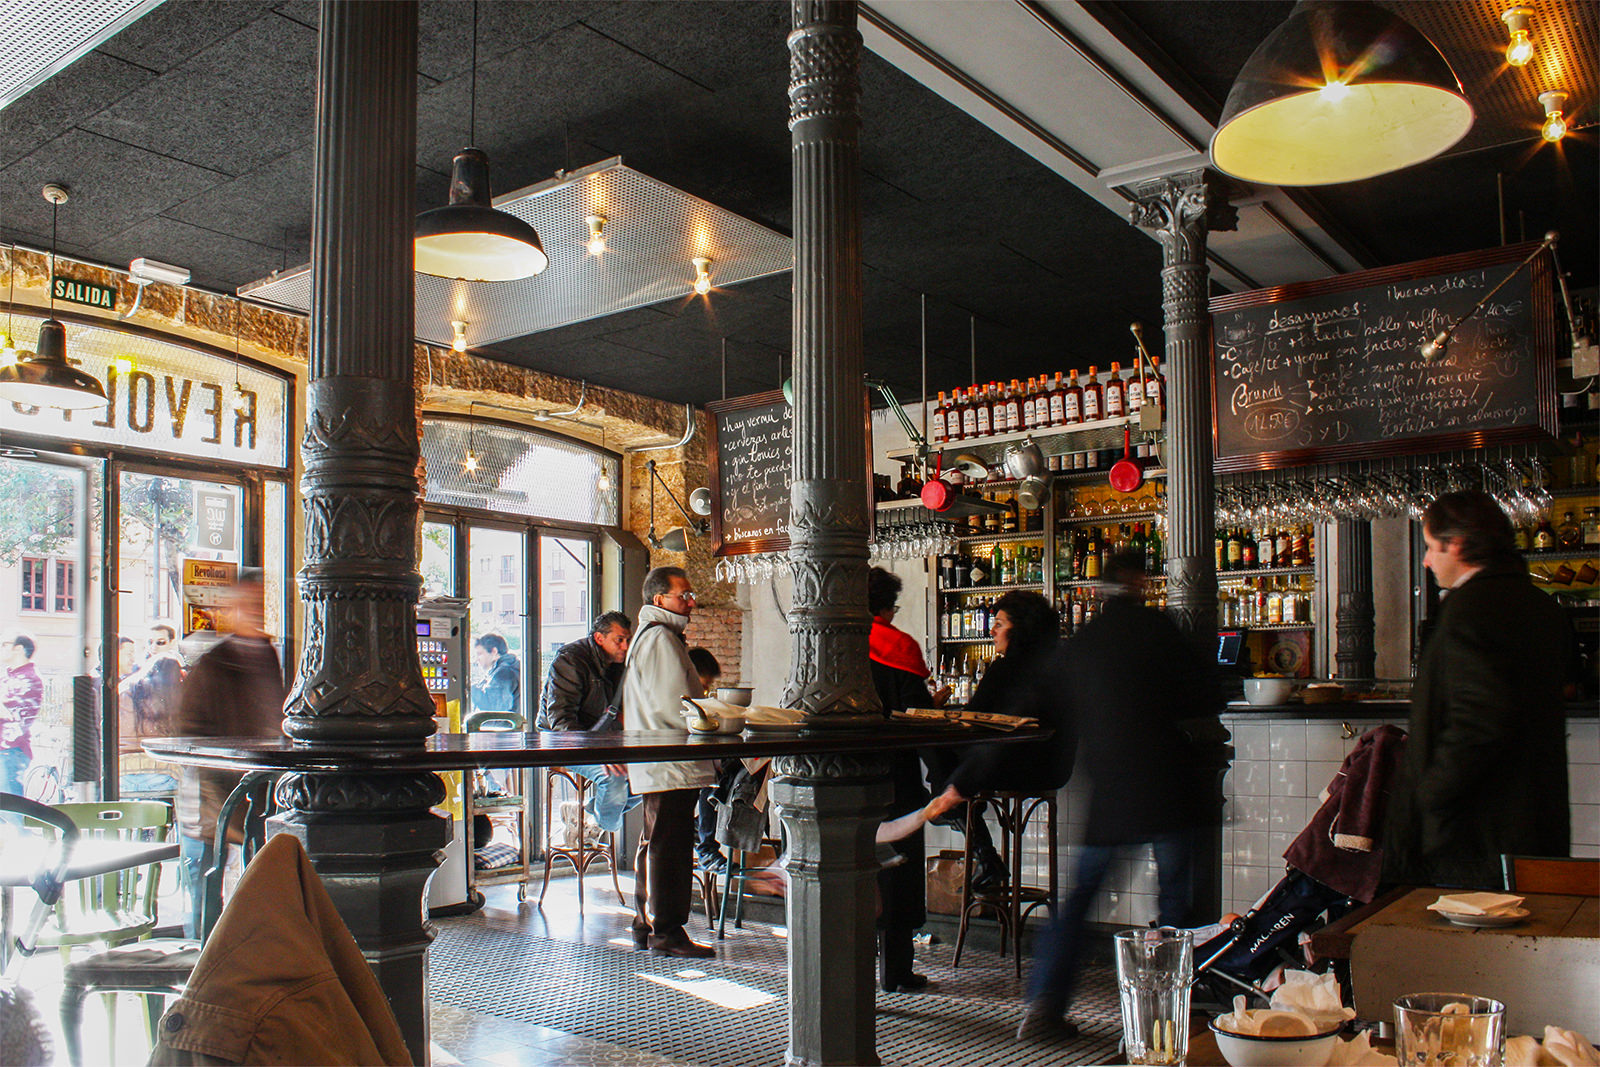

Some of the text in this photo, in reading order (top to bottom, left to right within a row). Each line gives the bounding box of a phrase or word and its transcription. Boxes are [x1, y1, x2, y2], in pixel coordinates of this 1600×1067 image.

[54, 279, 112, 308] SALIDA
[1231, 380, 1283, 416] Brunch
[725, 416, 746, 439] hay
